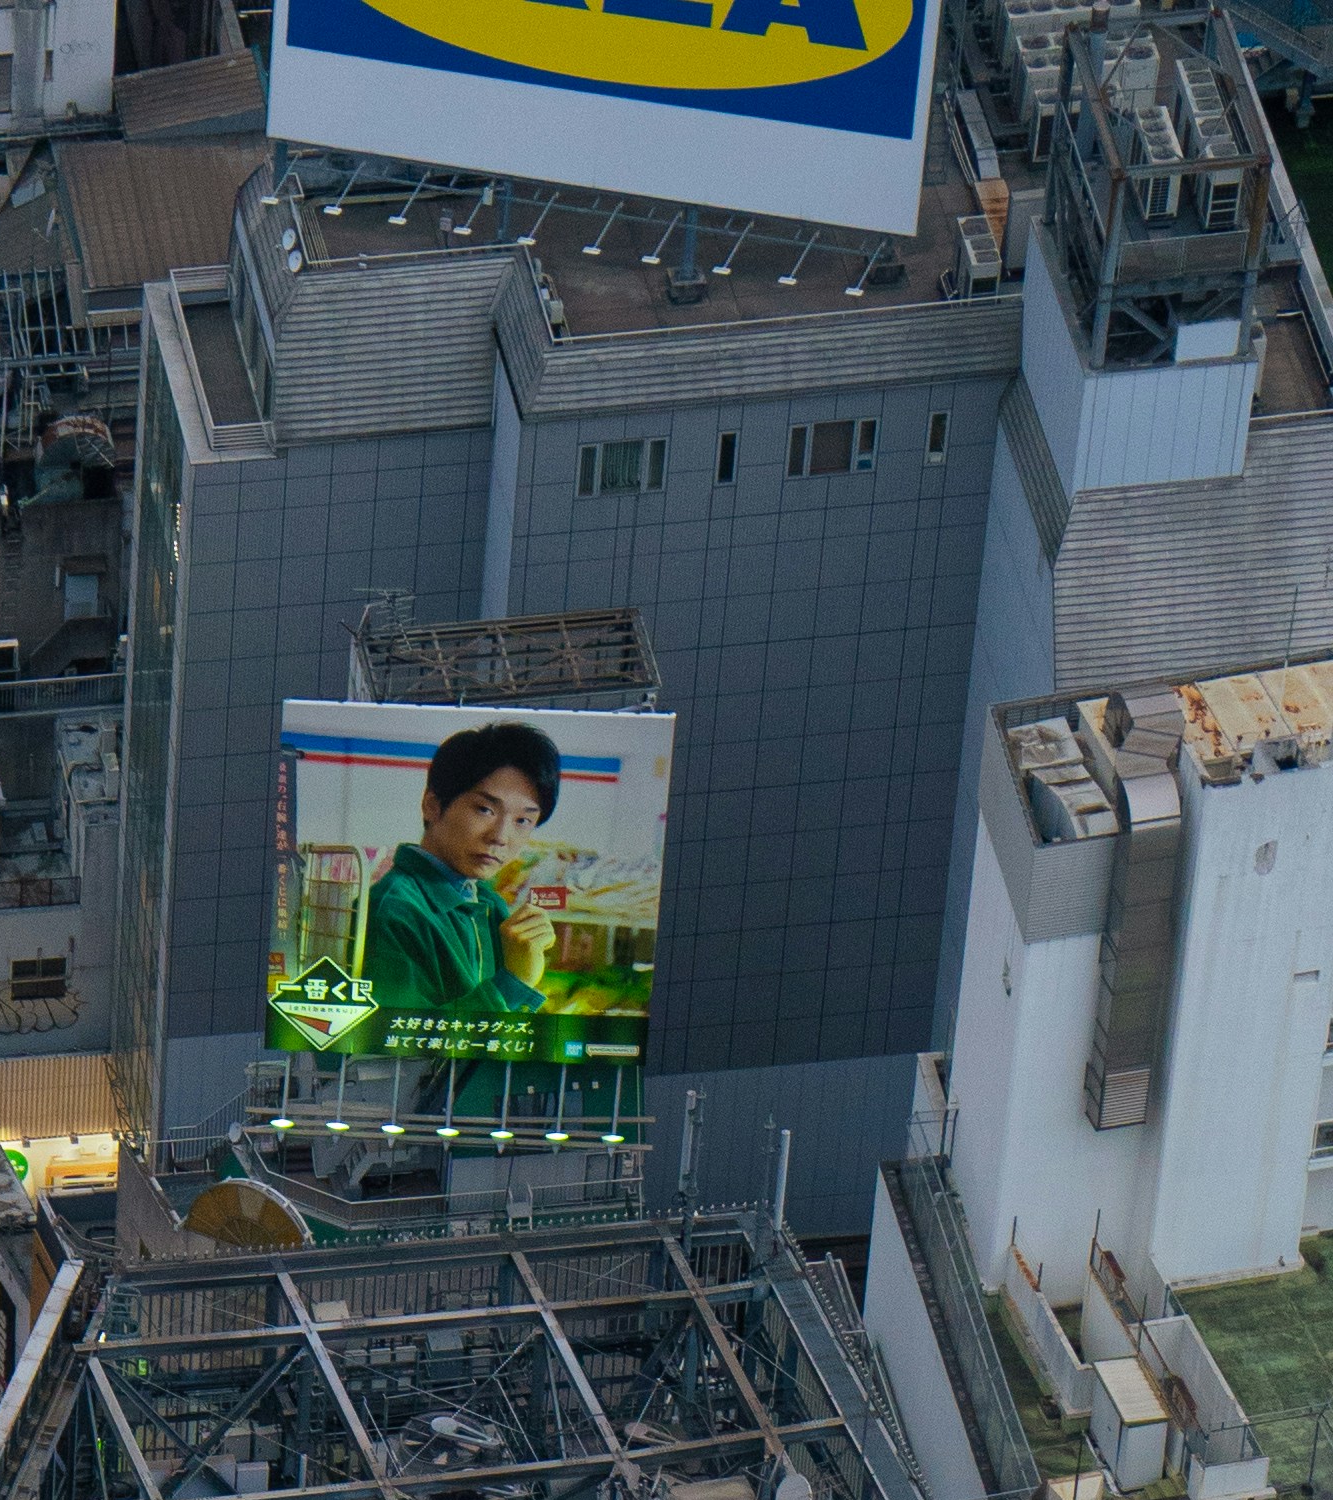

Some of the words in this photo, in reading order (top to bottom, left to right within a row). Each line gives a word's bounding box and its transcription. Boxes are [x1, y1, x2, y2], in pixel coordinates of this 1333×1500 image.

[276, 977, 374, 1004] 一番くじ
[389, 1015, 537, 1037] 大好きなキャラグッズ。
